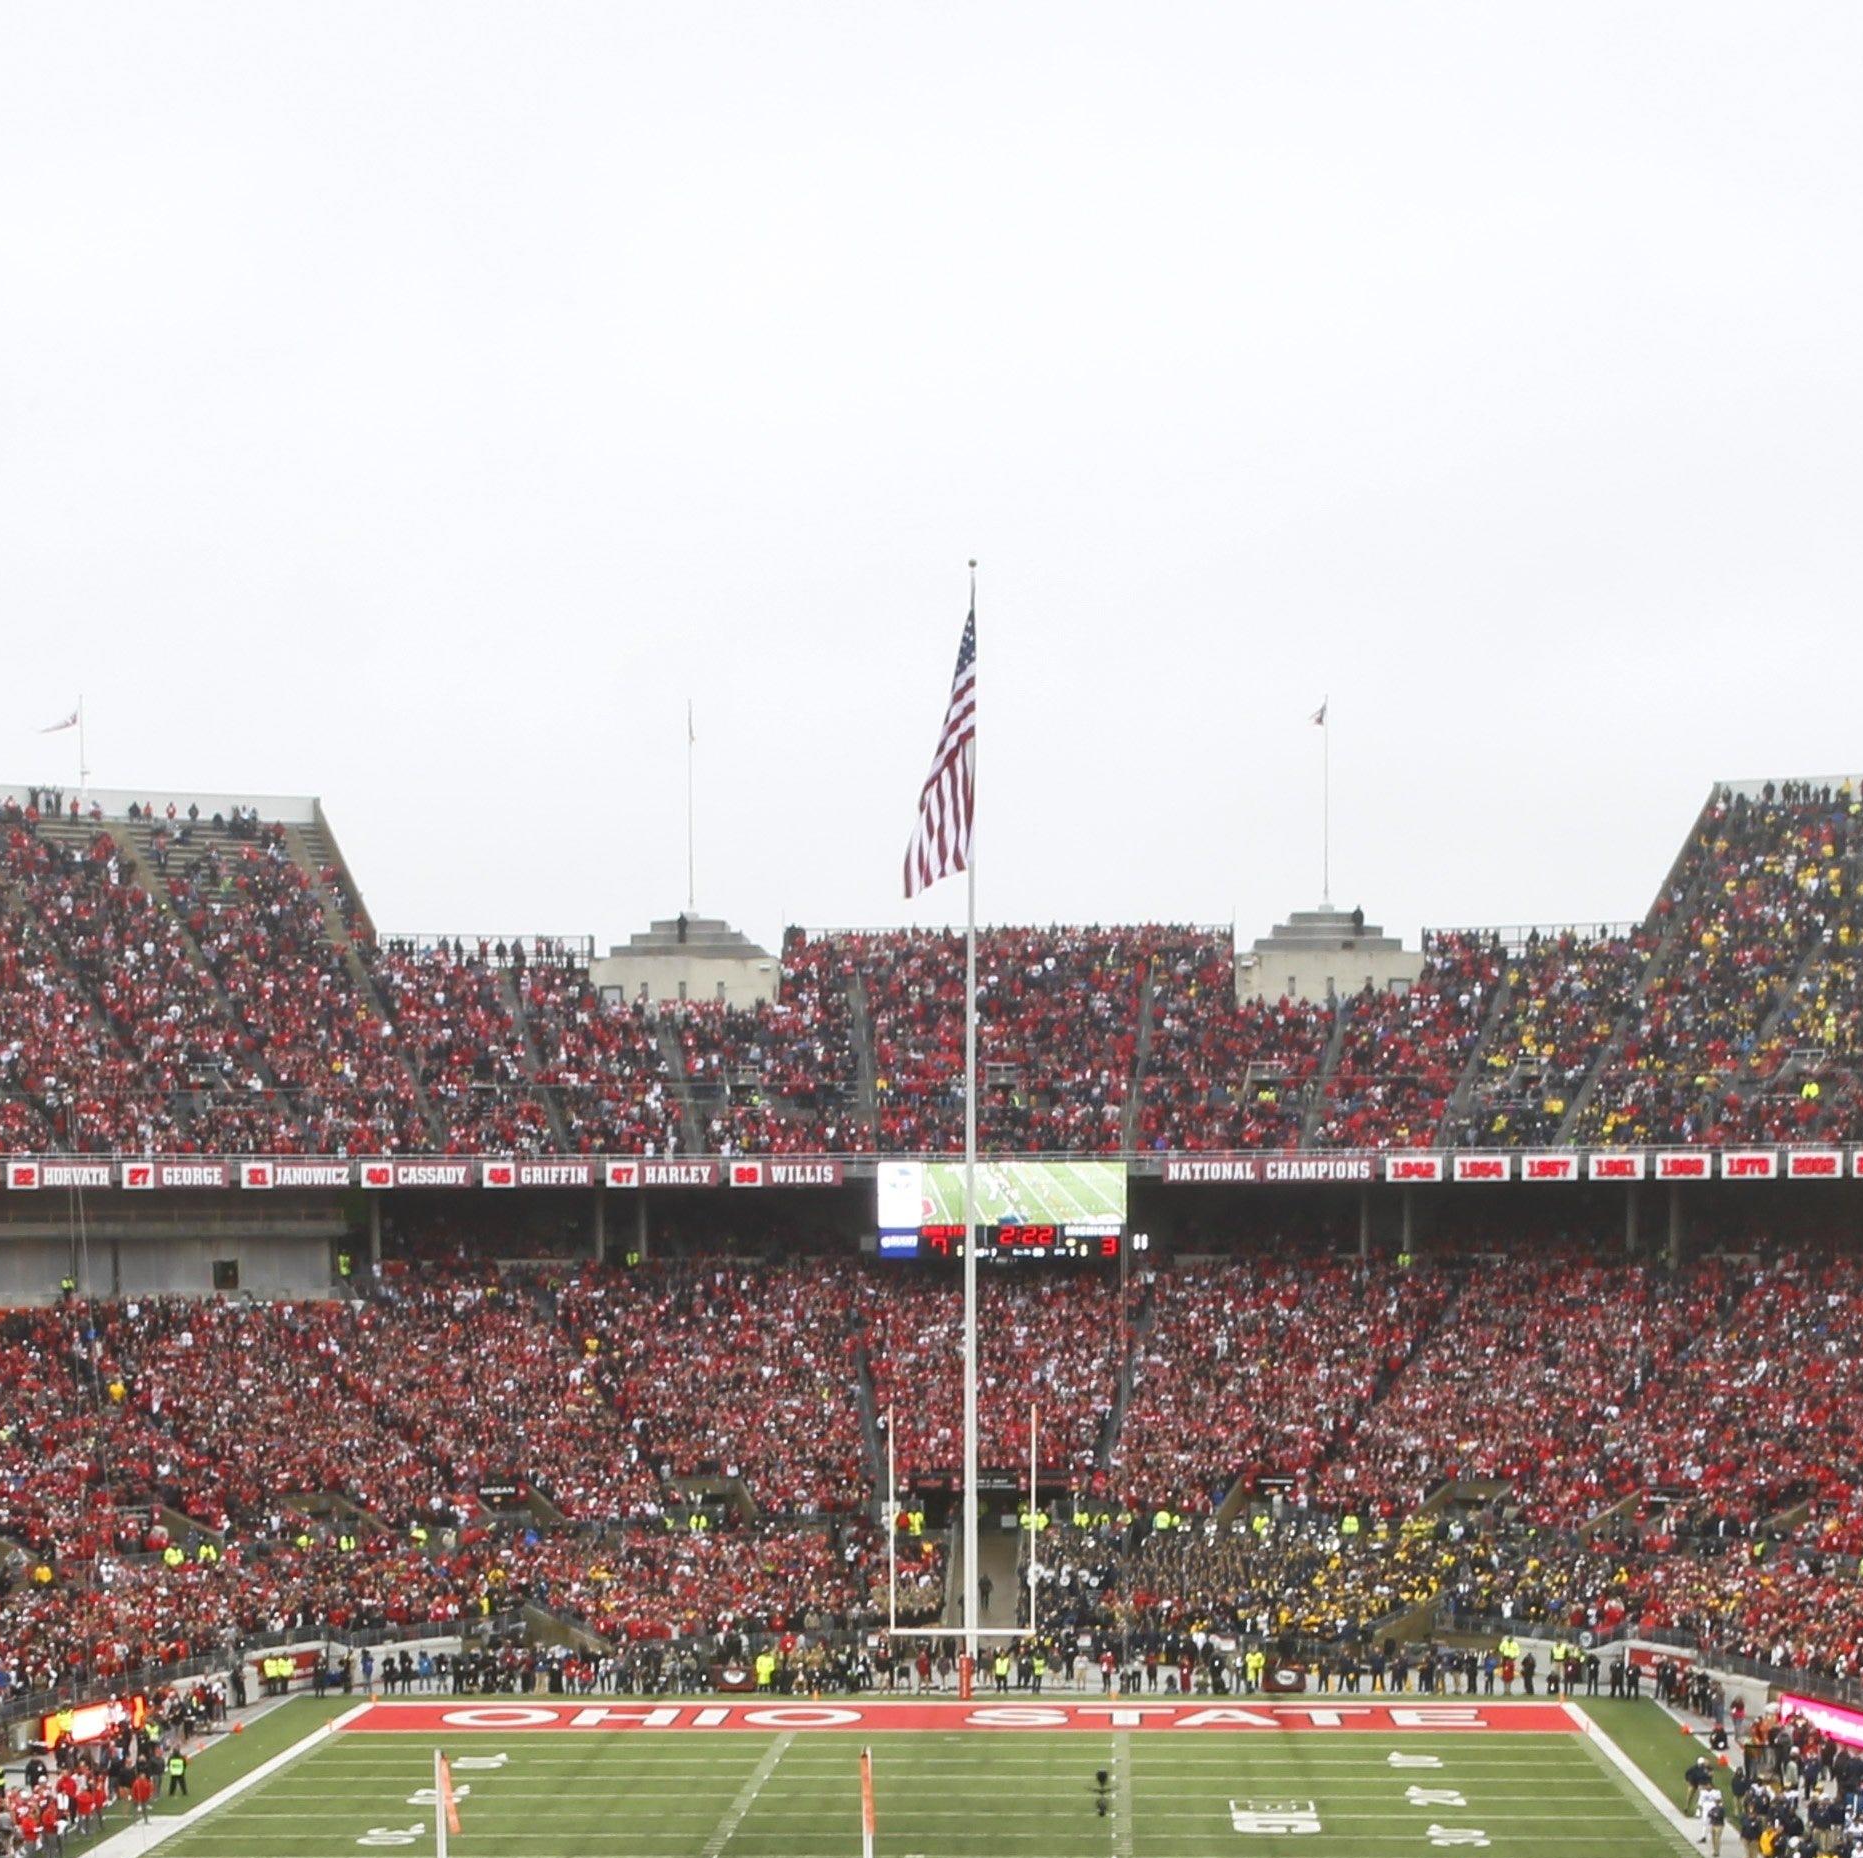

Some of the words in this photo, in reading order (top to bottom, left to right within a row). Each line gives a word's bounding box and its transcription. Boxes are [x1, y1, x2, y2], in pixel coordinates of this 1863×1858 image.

[42, 1167, 110, 1185] HORVATH
[127, 1167, 150, 1185] 27
[162, 1167, 223, 1185] GEORGE
[274, 1166, 350, 1185] JANOWICZ
[397, 1166, 467, 1185] CASSADY
[520, 1166, 589, 1184] GRIFFIN
[644, 1166, 712, 1184] HARLEY
[770, 1165, 834, 1183] WILLIS
[1167, 1162, 1256, 1181] NATIONAL
[1265, 1161, 1371, 1180] CHAMPIONS
[999, 1225, 1055, 1245] 2:22
[1064, 1225, 1121, 1236] MICHIGAN
[1101, 1237, 1117, 1256] 3
[479, 1486, 516, 1495] NISSAN
[442, 1707, 863, 1727] OHIO
[964, 1707, 1488, 1727] STATE
